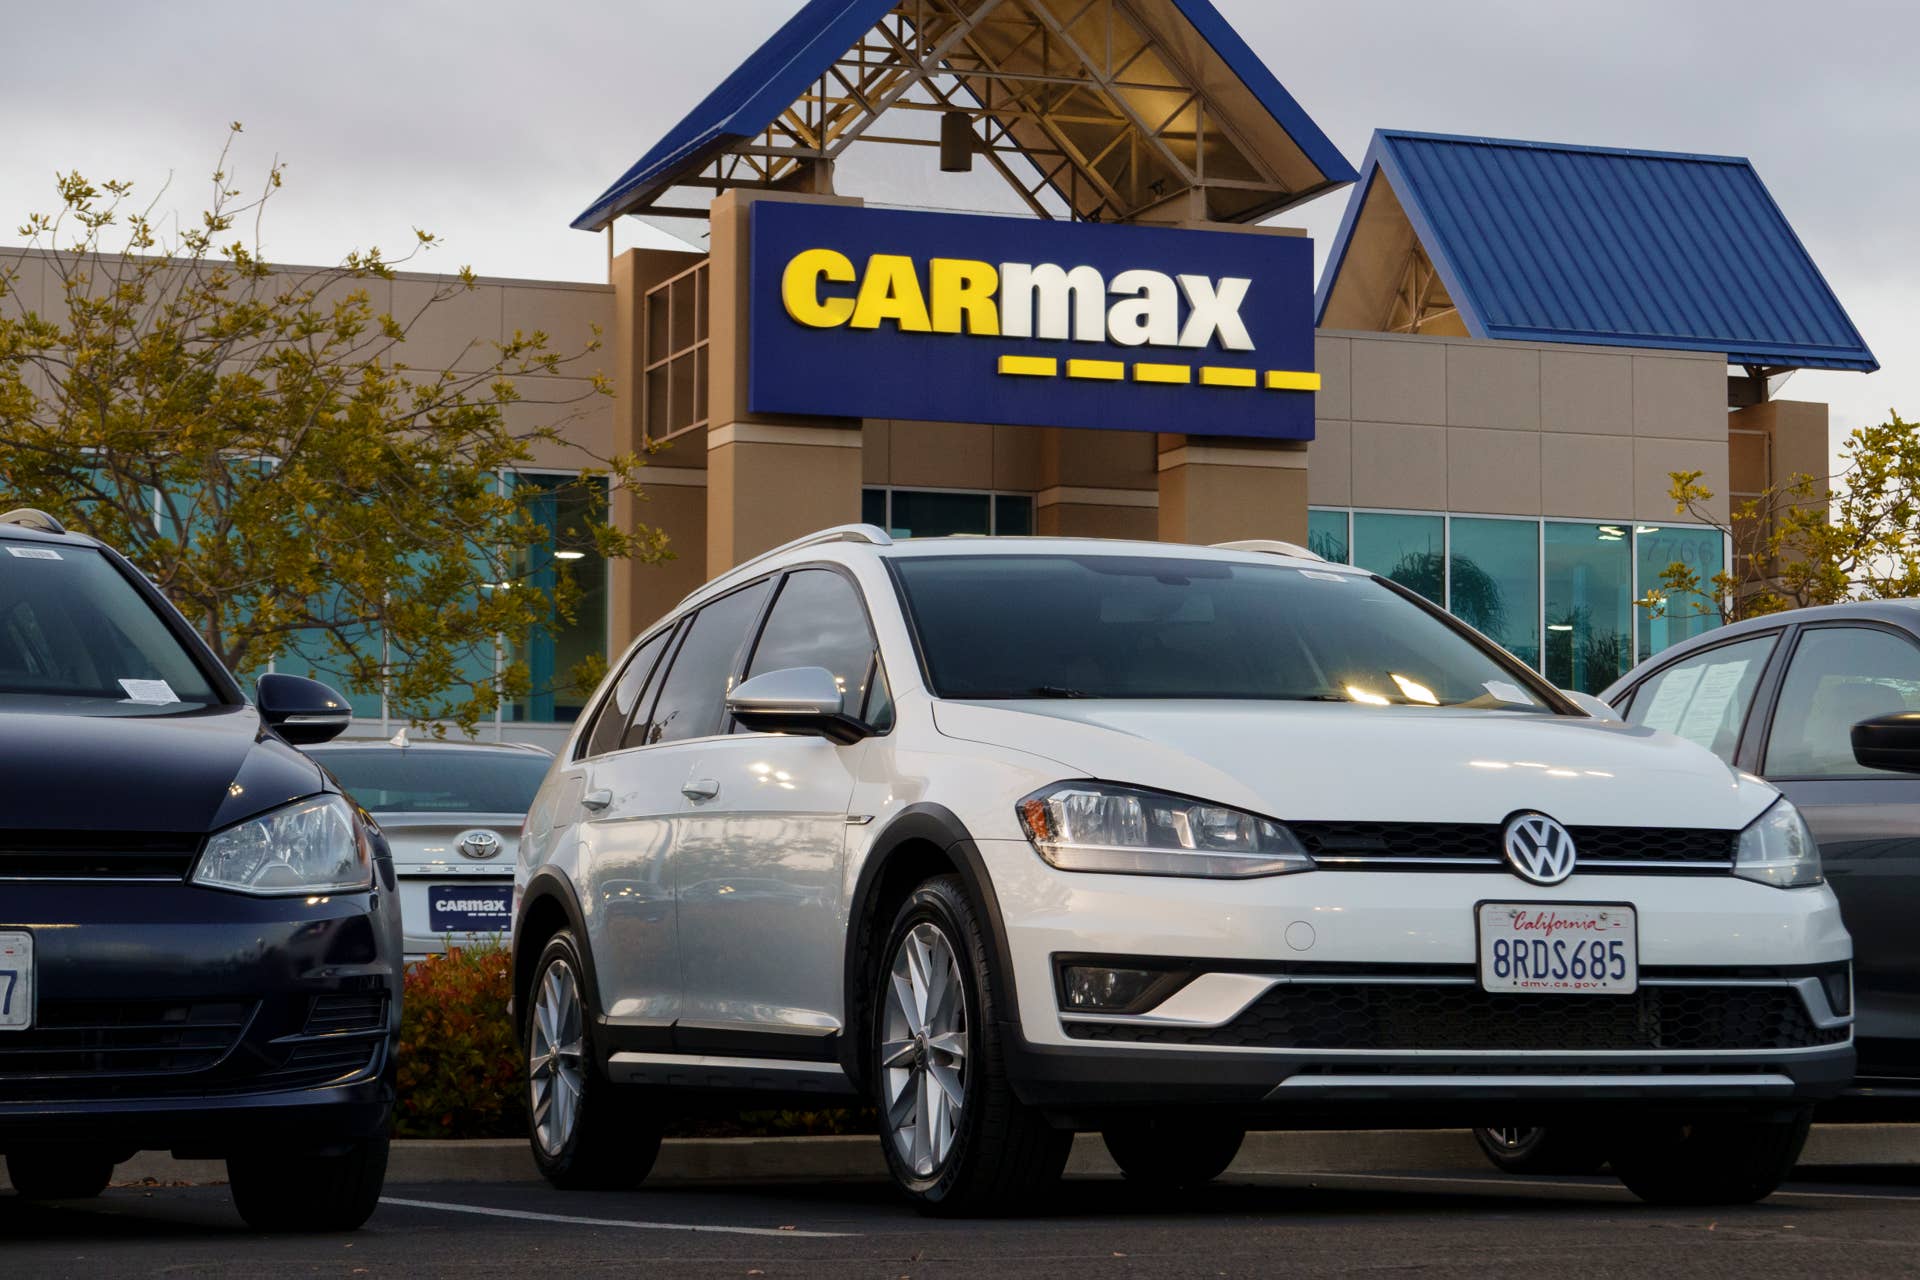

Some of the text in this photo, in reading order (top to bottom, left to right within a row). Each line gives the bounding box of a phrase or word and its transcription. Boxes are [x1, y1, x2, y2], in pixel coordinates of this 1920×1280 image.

[781, 248, 1256, 351] CARmax
[435, 899, 506, 912] CARmax
[1513, 911, 1607, 936] California
[1493, 939, 1626, 980] 8RDS685
[1521, 980, 1598, 988] dmv.ca.gov
